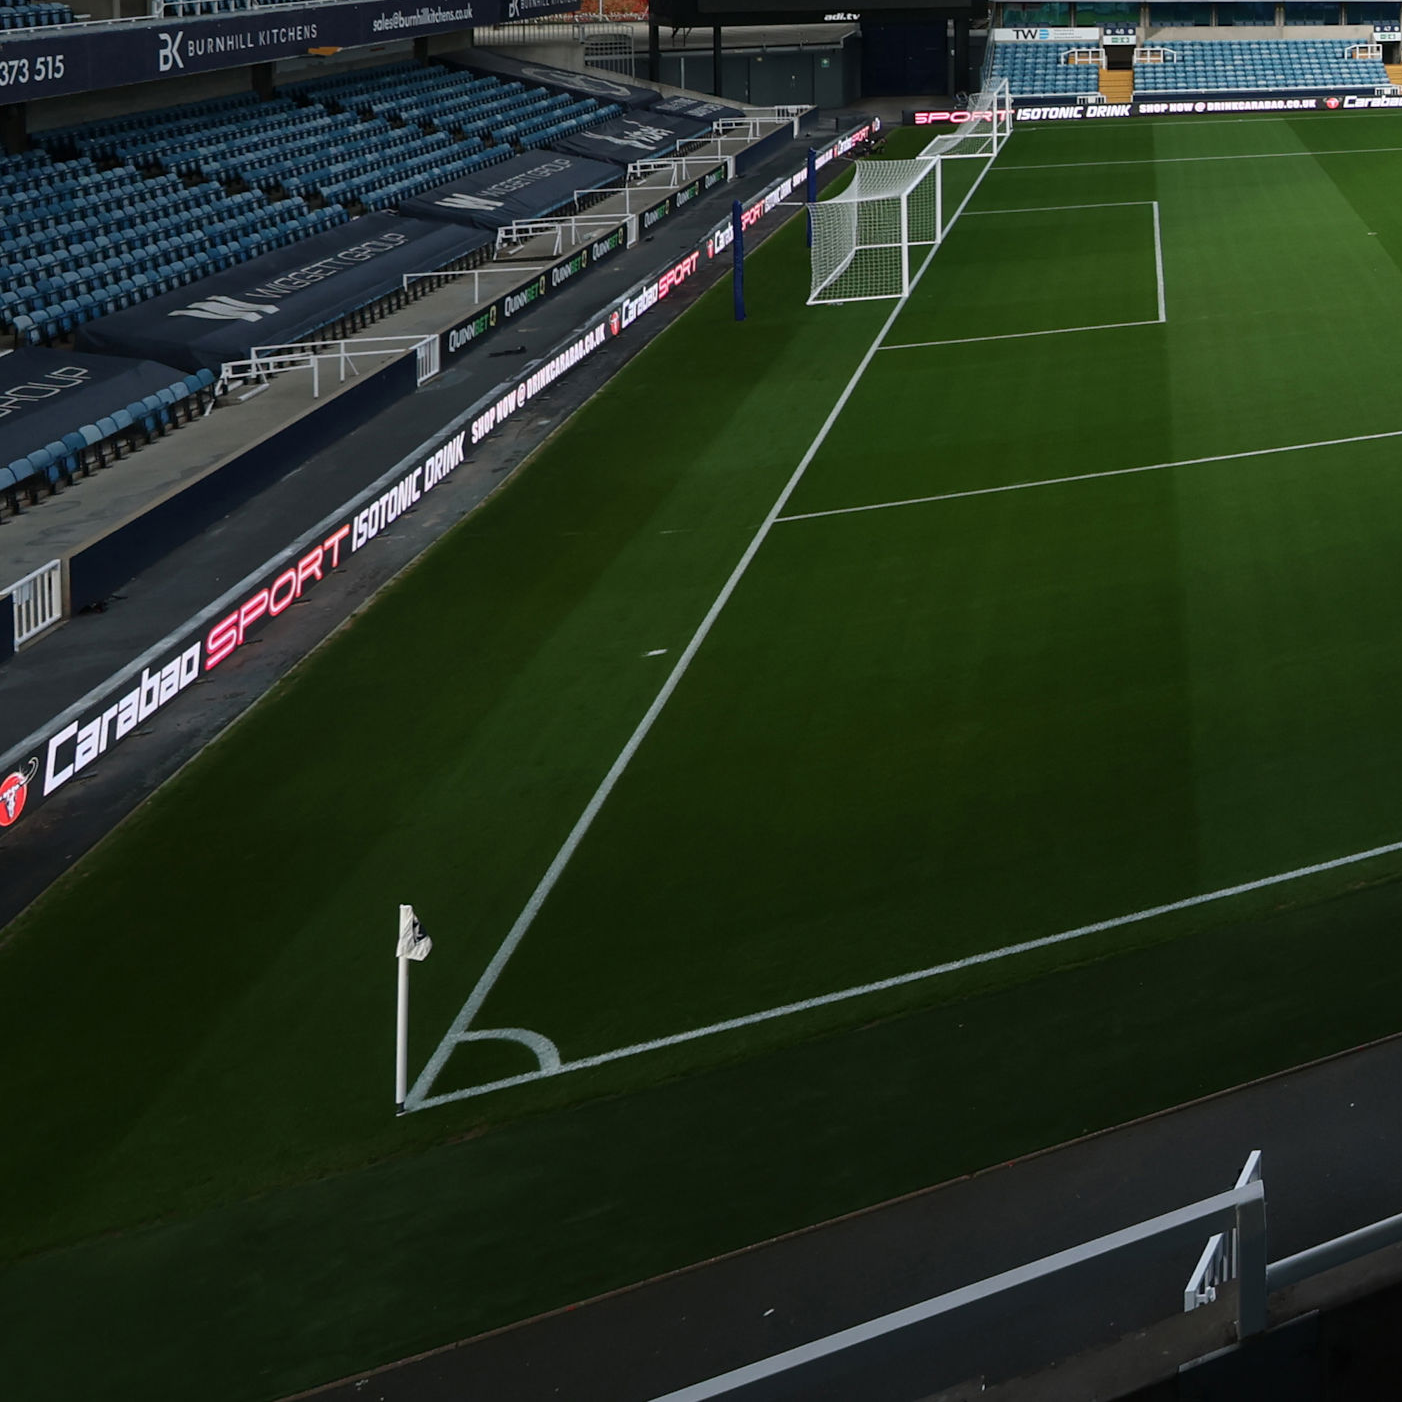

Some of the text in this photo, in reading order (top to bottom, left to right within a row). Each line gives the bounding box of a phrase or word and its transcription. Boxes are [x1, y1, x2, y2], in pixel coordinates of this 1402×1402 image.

[372, 2, 473, 39] sales@burnhillkitchens.co.uk
[187, 29, 318, 63] BURNHILL KITCHENS
[34, 54, 65, 83] 515
[1016, 105, 1084, 121] ISOTONIC
[1086, 104, 1132, 118] DRINK
[1138, 99, 1316, 114] SHOP NOW @ DRINKCARABAO.CO.UK
[245, 232, 410, 299] WIGGETT GROUP
[552, 254, 582, 287] QUINNBET
[504, 283, 538, 318] QUINNBET
[621, 250, 700, 329] Carabao SPORT
[449, 311, 489, 353] QUINNBET
[471, 322, 606, 445] SHOP NOW @ DRINKCARABAO.CO.UK
[44, 429, 466, 797] Carabao SPORT ISOTONIC DRINK
